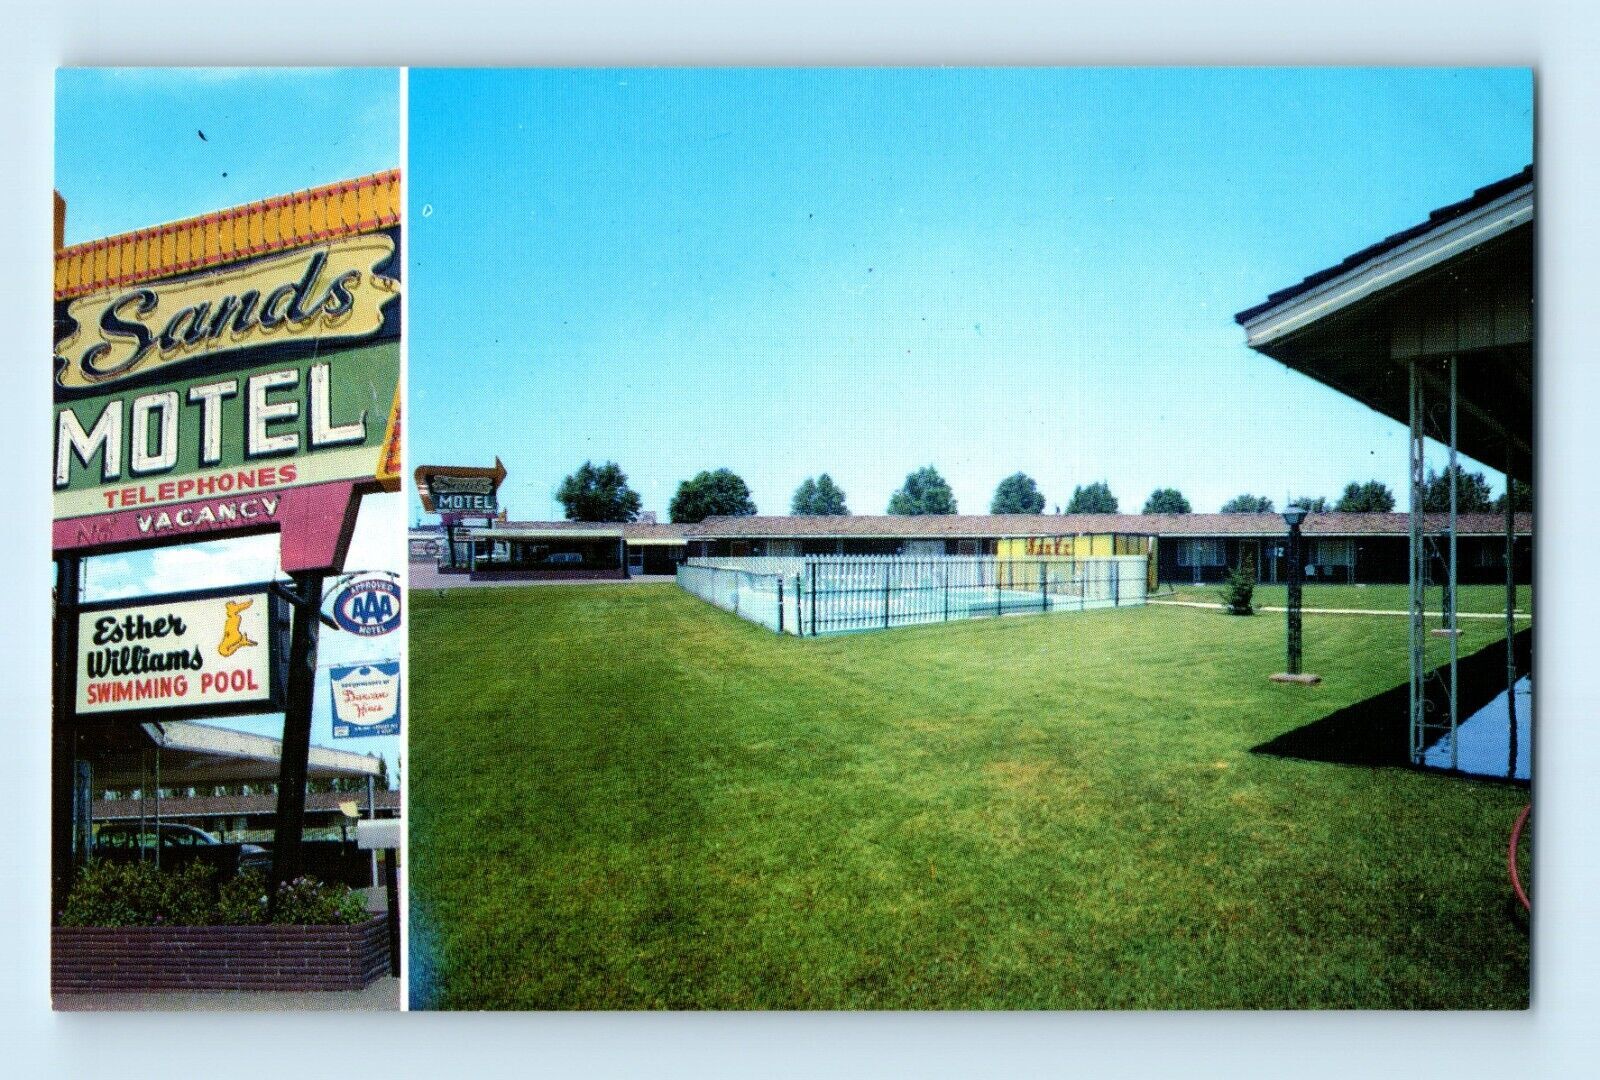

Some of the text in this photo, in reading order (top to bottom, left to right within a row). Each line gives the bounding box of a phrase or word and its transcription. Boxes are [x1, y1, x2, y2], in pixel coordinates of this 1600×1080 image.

[81, 250, 361, 379] Sands
[54, 363, 366, 487] MOTEL
[103, 464, 298, 509] TELEPHONES
[438, 495, 494, 509] MOTEL
[136, 494, 281, 533] VACANCY
[350, 581, 394, 594] APPROVED
[352, 590, 393, 624] AAA
[93, 613, 187, 646] Esther
[358, 625, 387, 635] MOTEL
[87, 644, 203, 679] Williams
[87, 668, 259, 705] SWIMMING POOL
